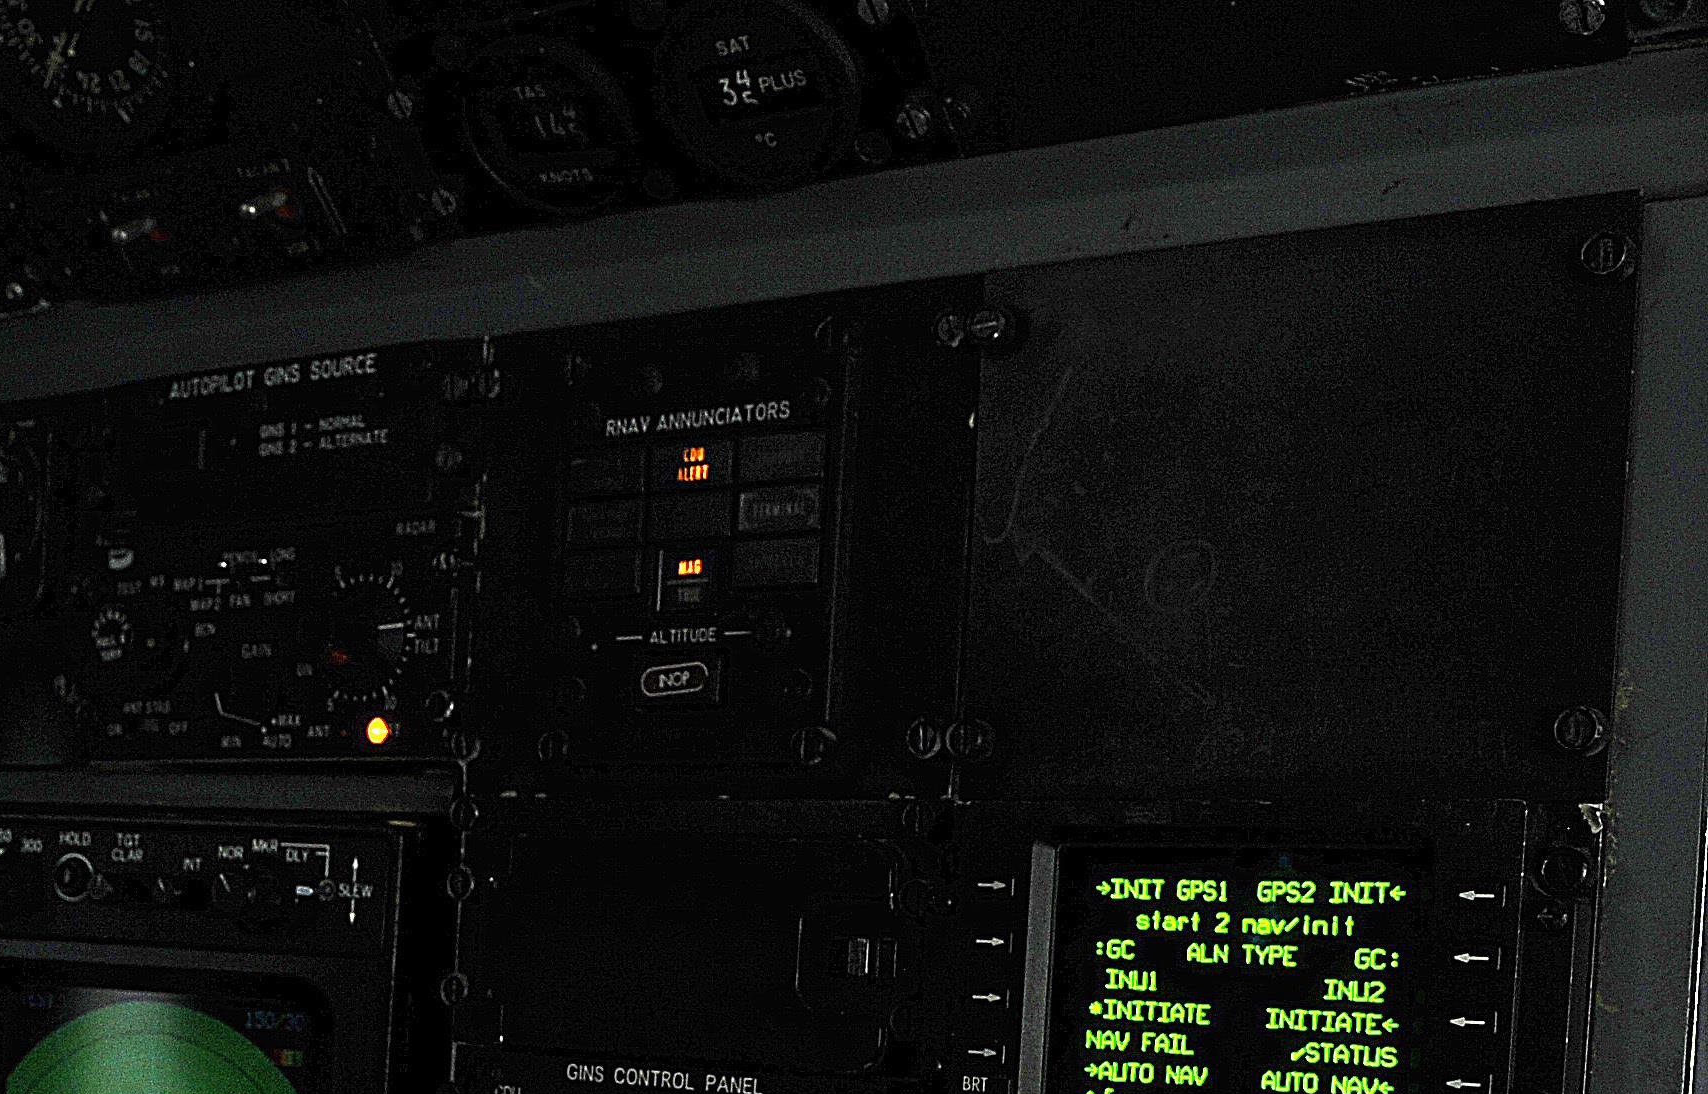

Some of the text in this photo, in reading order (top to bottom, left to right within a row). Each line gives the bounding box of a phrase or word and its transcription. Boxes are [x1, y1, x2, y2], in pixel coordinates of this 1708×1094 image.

[714, 34, 750, 57] SAT
[757, 68, 808, 94] PLUS
[169, 370, 256, 400] AUTOPILOT
[309, 352, 378, 382] SOURCE
[319, 414, 366, 432] NORMAL
[605, 401, 791, 437] RNAV ANNUNCIATORS
[318, 428, 389, 450] ALTERNATE
[676, 463, 710, 482] ALERT
[395, 519, 436, 536] RADAR
[414, 613, 440, 630] ANT
[414, 637, 440, 655] TILT
[648, 625, 718, 645] ALTITUDE
[59, 831, 92, 846] HOLD
[116, 834, 141, 849] TGT
[252, 838, 279, 854] MKR
[217, 845, 245, 861] NOR
[285, 848, 310, 863] DLY
[338, 883, 374, 899] SLEW
[1112, 876, 1387, 905] INIT GPS1 GPS2 INIT
[1135, 910, 1356, 937] start 2 nav/init
[1186, 942, 1230, 964] ALN
[1241, 943, 1299, 968] TYPE
[1103, 967, 1159, 993] INU1
[1322, 977, 1387, 1003] INU2
[1102, 998, 1384, 1035] INITIATE INITIATE
[1084, 1029, 1194, 1058] NAV FAIL
[565, 1063, 604, 1084] GINS
[613, 1066, 695, 1092] CONTROL
[961, 1074, 989, 1094] BRT
[1098, 1062, 1155, 1086] AUTO
[1165, 1064, 1210, 1088] NAV
[1260, 1070, 1320, 1094] AUTO
